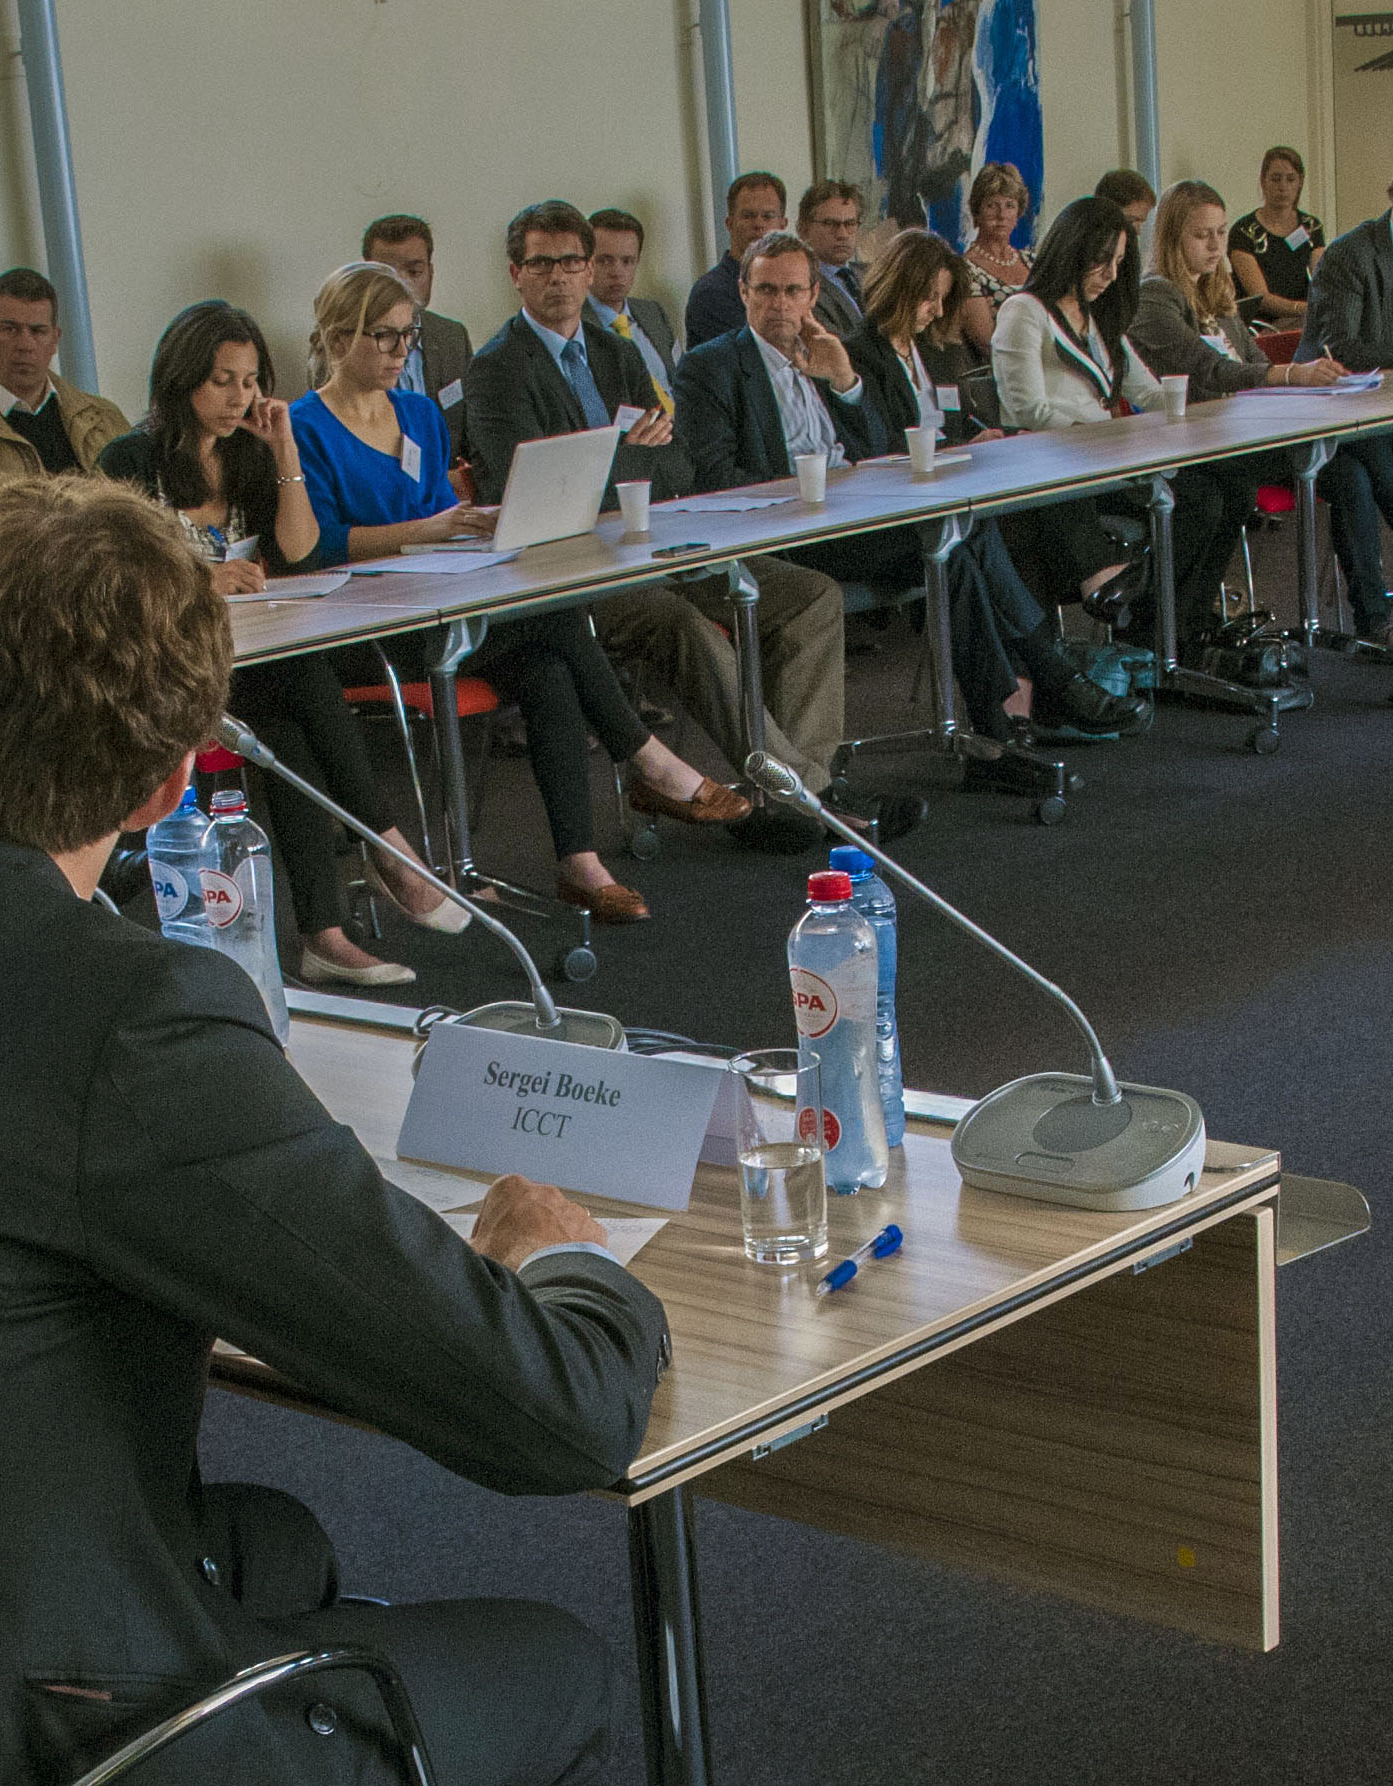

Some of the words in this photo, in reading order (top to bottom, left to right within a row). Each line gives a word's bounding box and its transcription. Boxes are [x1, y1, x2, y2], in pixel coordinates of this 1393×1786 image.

[154, 880, 179, 898] PA
[483, 1060, 552, 1098] Sergei
[554, 1073, 622, 1107] Boeke
[510, 1106, 573, 1139] ICCT
